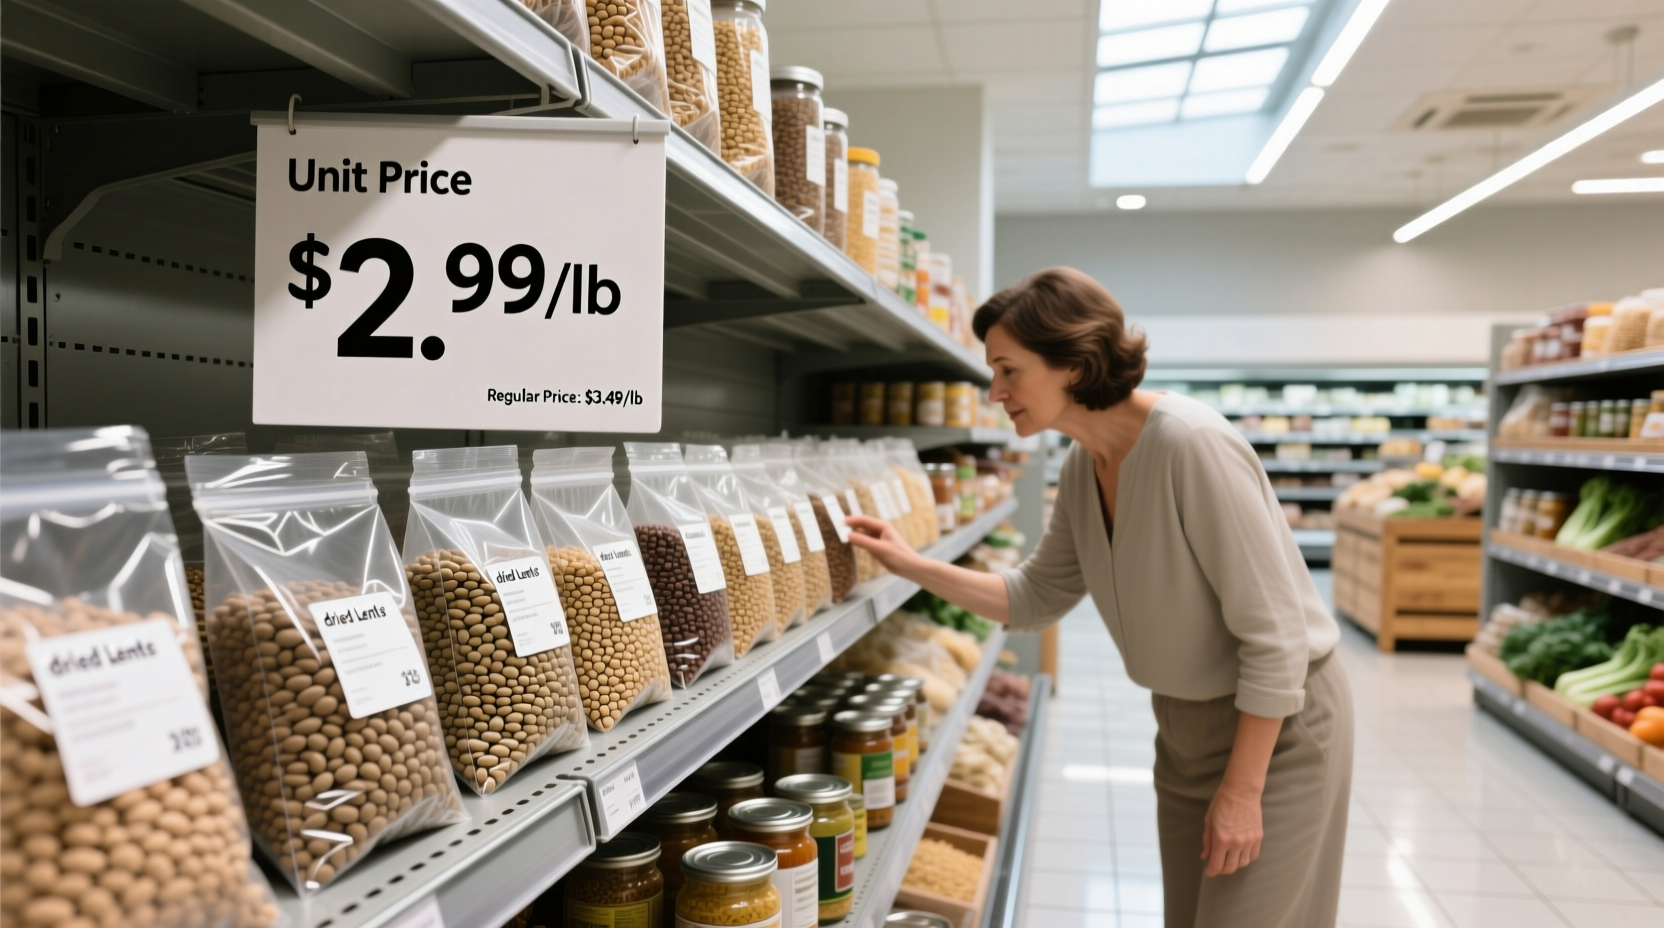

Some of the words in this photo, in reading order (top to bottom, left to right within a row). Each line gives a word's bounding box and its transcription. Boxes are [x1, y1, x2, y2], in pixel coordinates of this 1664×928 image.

[288, 158, 368, 194] Unit
[379, 160, 472, 196] Price
[287, 232, 621, 361] $2.99/lb
[487, 388, 541, 406] Regular
[543, 389, 582, 405] Price:
[584, 388, 644, 408] $3.49/lb
